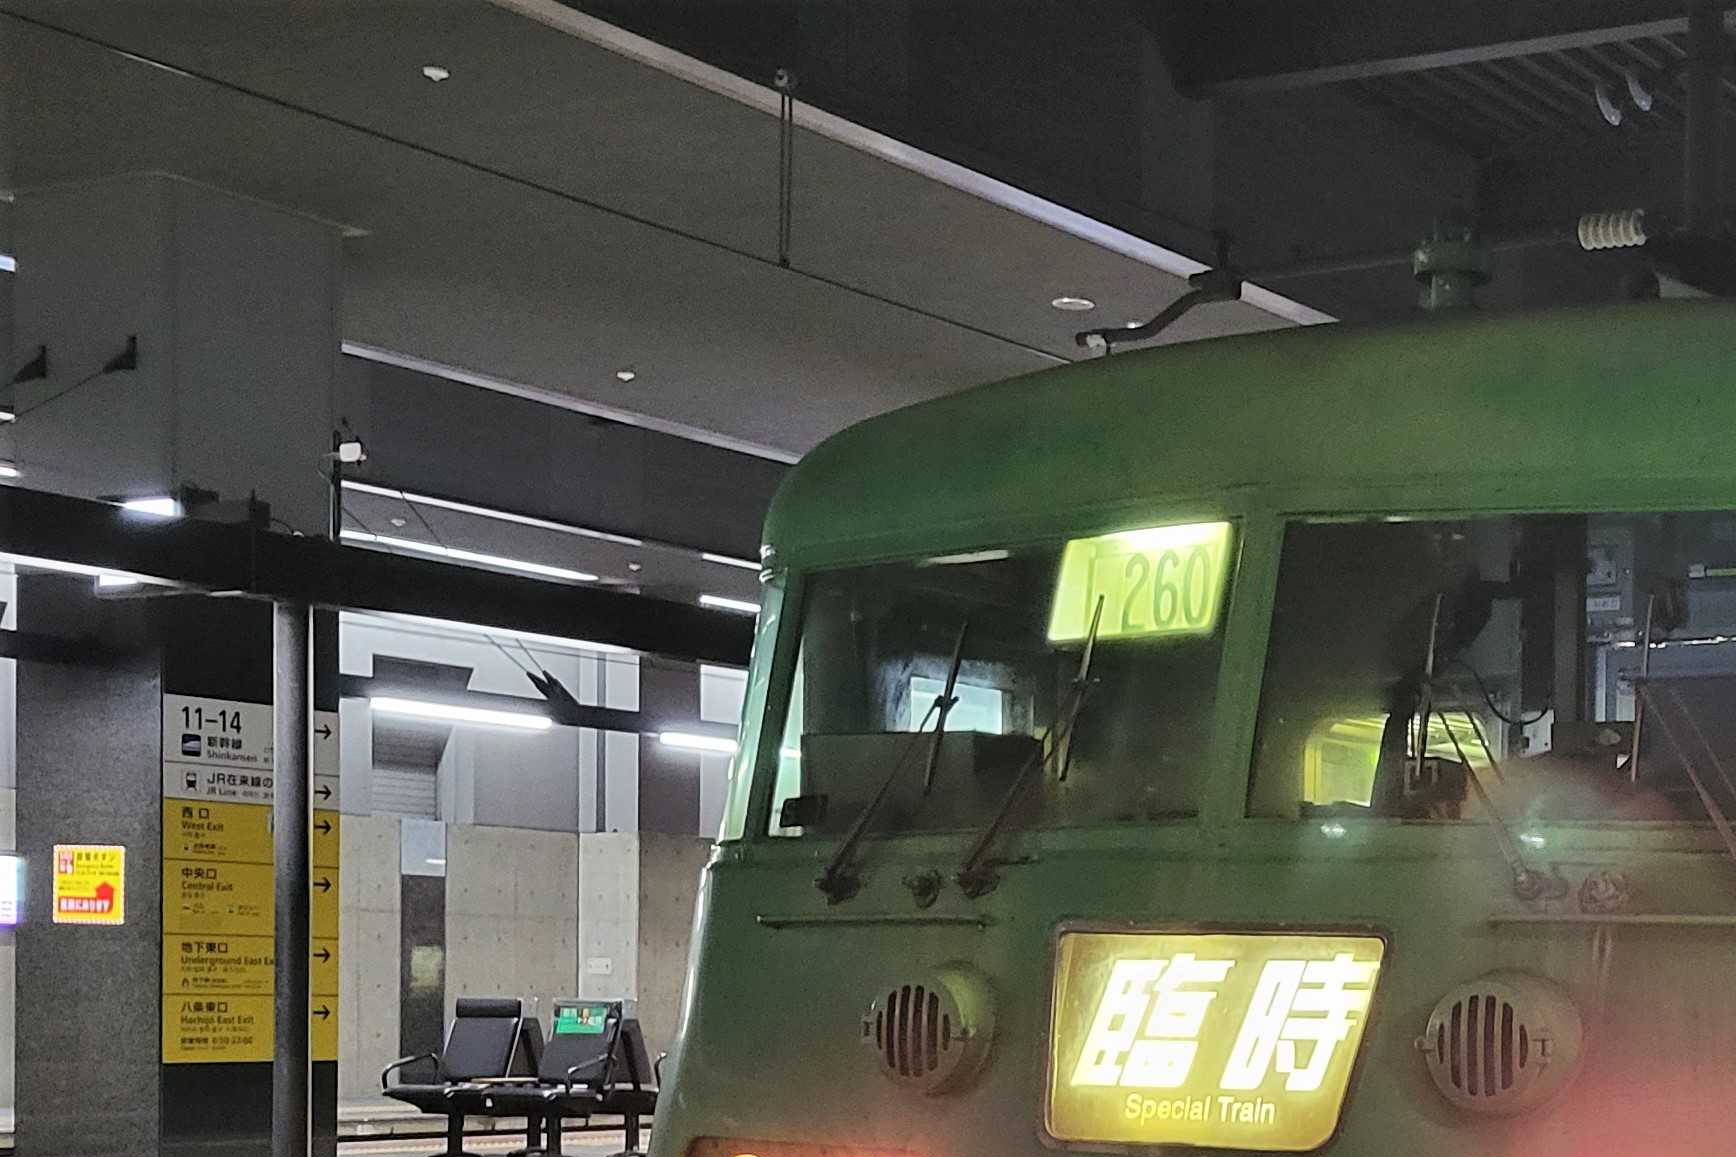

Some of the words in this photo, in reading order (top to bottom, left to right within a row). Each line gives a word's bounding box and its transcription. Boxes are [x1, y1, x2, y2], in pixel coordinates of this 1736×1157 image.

[182, 867, 217, 880] 中央口
[1070, 952, 1381, 1092] 臨時
[1125, 1093, 1210, 1126] Special
[1218, 1095, 1277, 1124] Train
